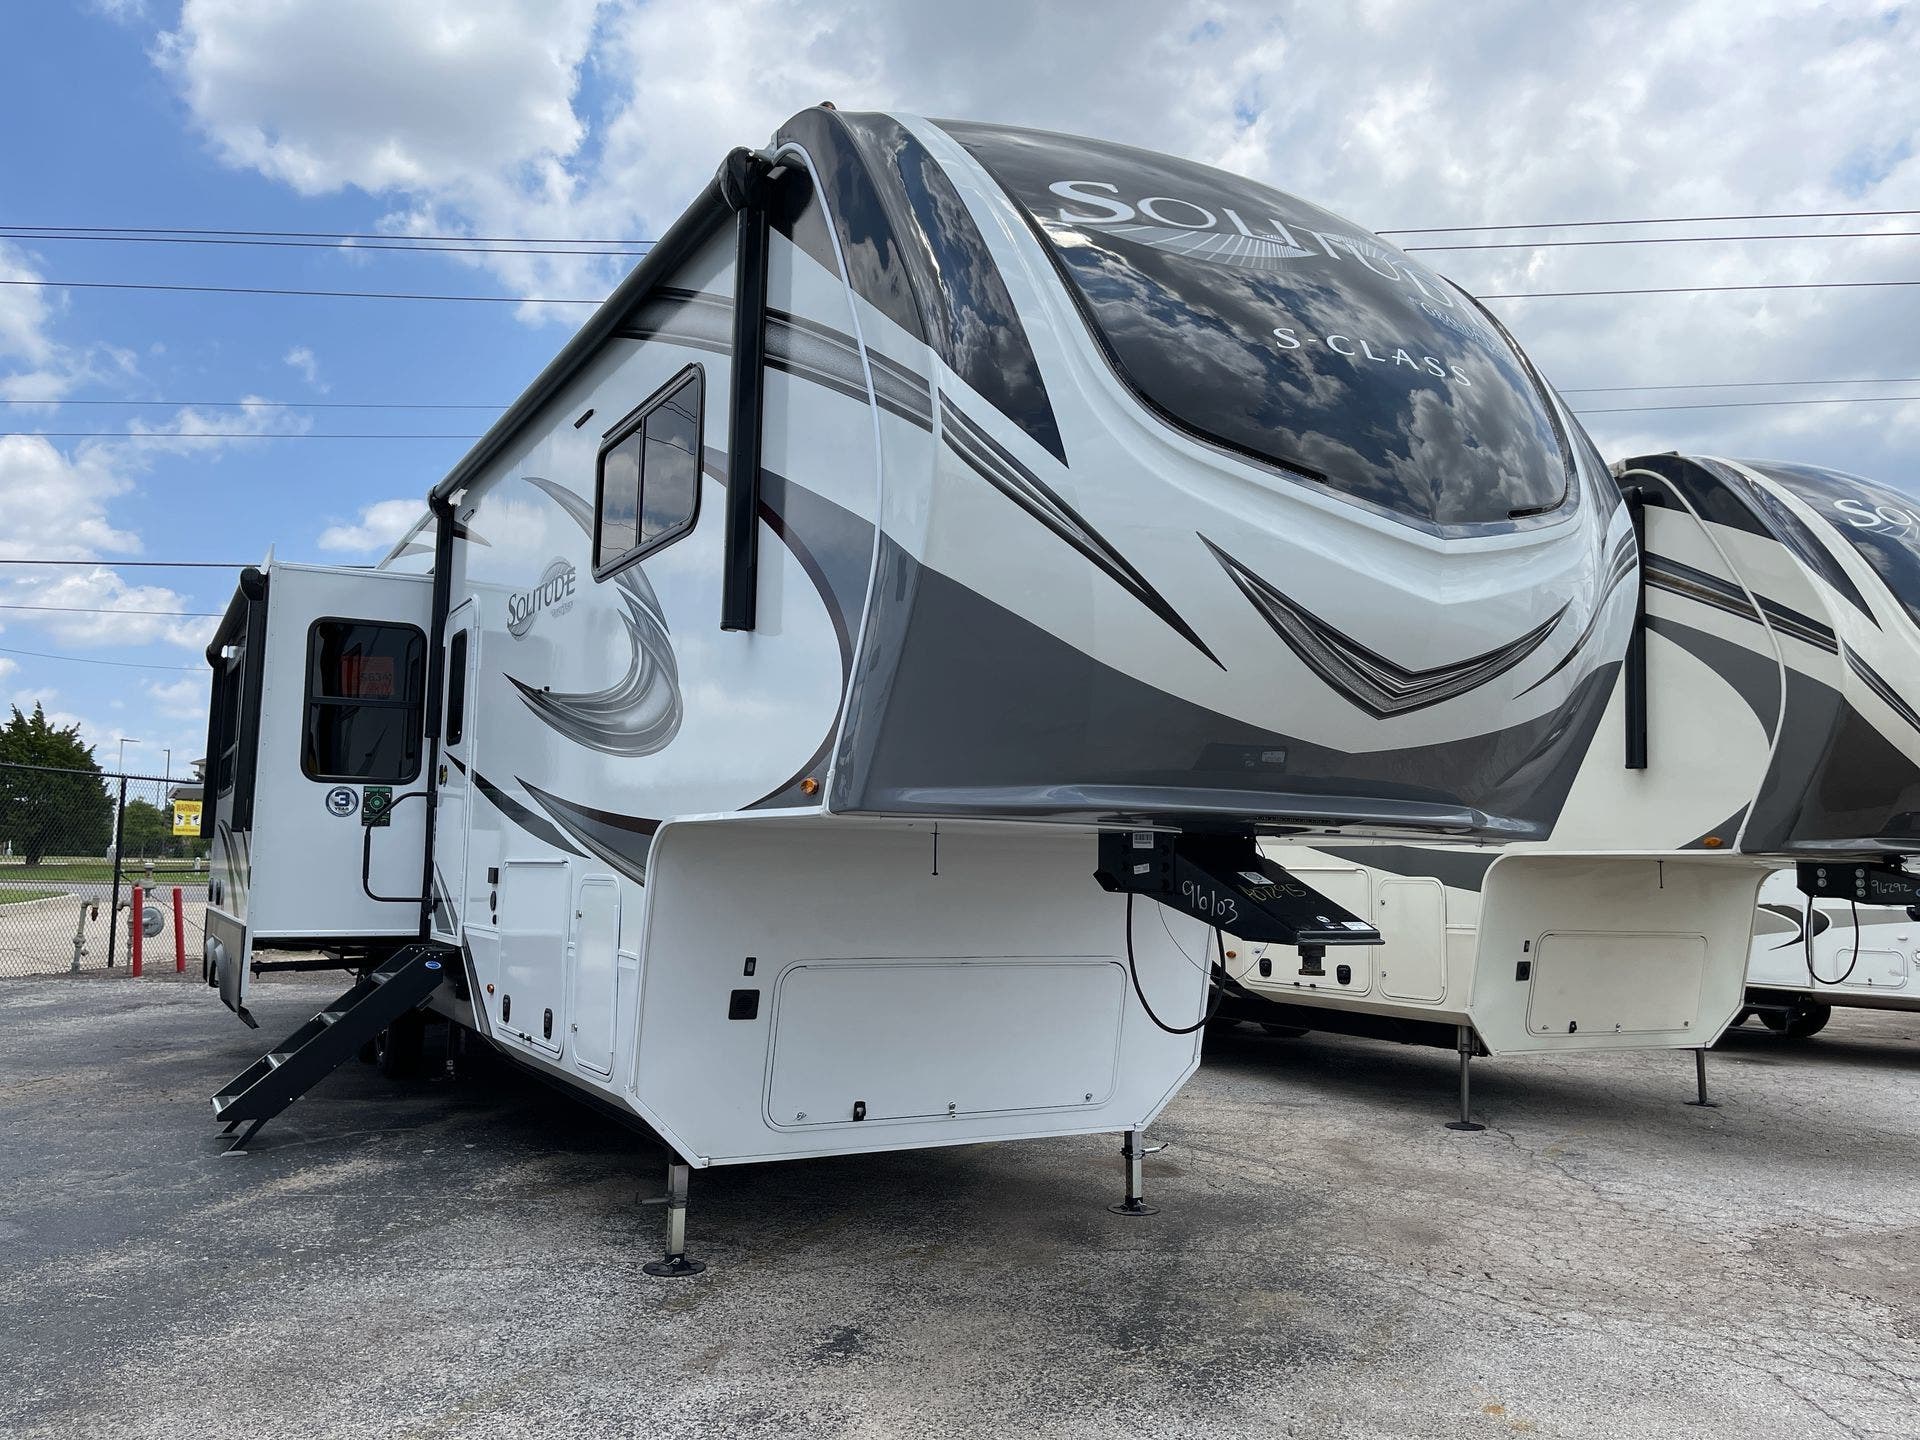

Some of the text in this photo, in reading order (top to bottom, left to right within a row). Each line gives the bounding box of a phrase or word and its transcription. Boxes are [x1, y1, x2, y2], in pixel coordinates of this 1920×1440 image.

[1273, 328, 1471, 386] S-CLASS
[507, 566, 576, 628] SOLITUDE
[334, 791, 350, 806] 3
[1871, 879, 1912, 894] 96292
